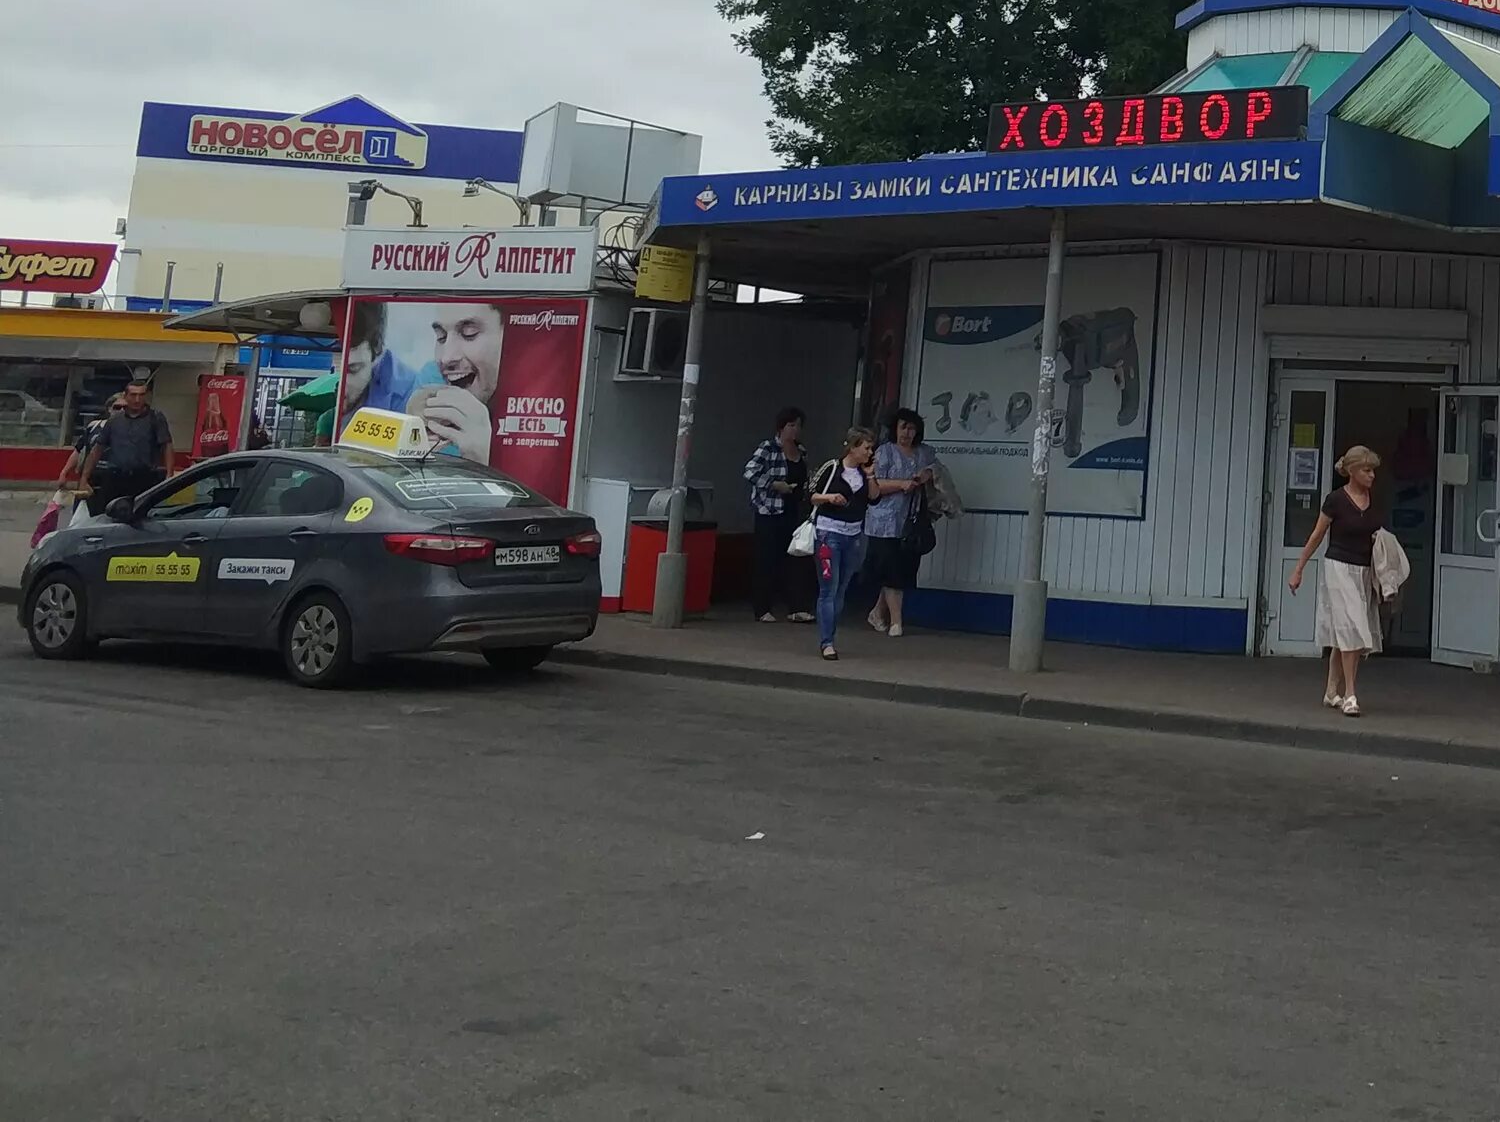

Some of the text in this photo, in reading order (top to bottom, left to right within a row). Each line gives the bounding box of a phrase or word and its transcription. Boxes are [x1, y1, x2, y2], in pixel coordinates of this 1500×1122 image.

[191, 143, 361, 163] ТОРГОВЫЙ КОМПЛЕКС
[734, 180, 842, 206] КАРНИЗЫ
[850, 176, 931, 200] ЗАМКИ
[940, 166, 1118, 194] САНТЕХНИКА
[371, 241, 450, 272] РУССКИЙ
[495, 247, 576, 274] АППЕТИТ
[952, 315, 992, 333] Bort
[507, 397, 565, 415] ВКУСНО
[353, 420, 396, 440] 55 55 55
[518, 418, 546, 432] ЕСТЬ
[503, 438, 559, 448] не запретишь
[115, 562, 190, 576] maxim 55 55 55
[226, 563, 286, 575] Закажи такси
